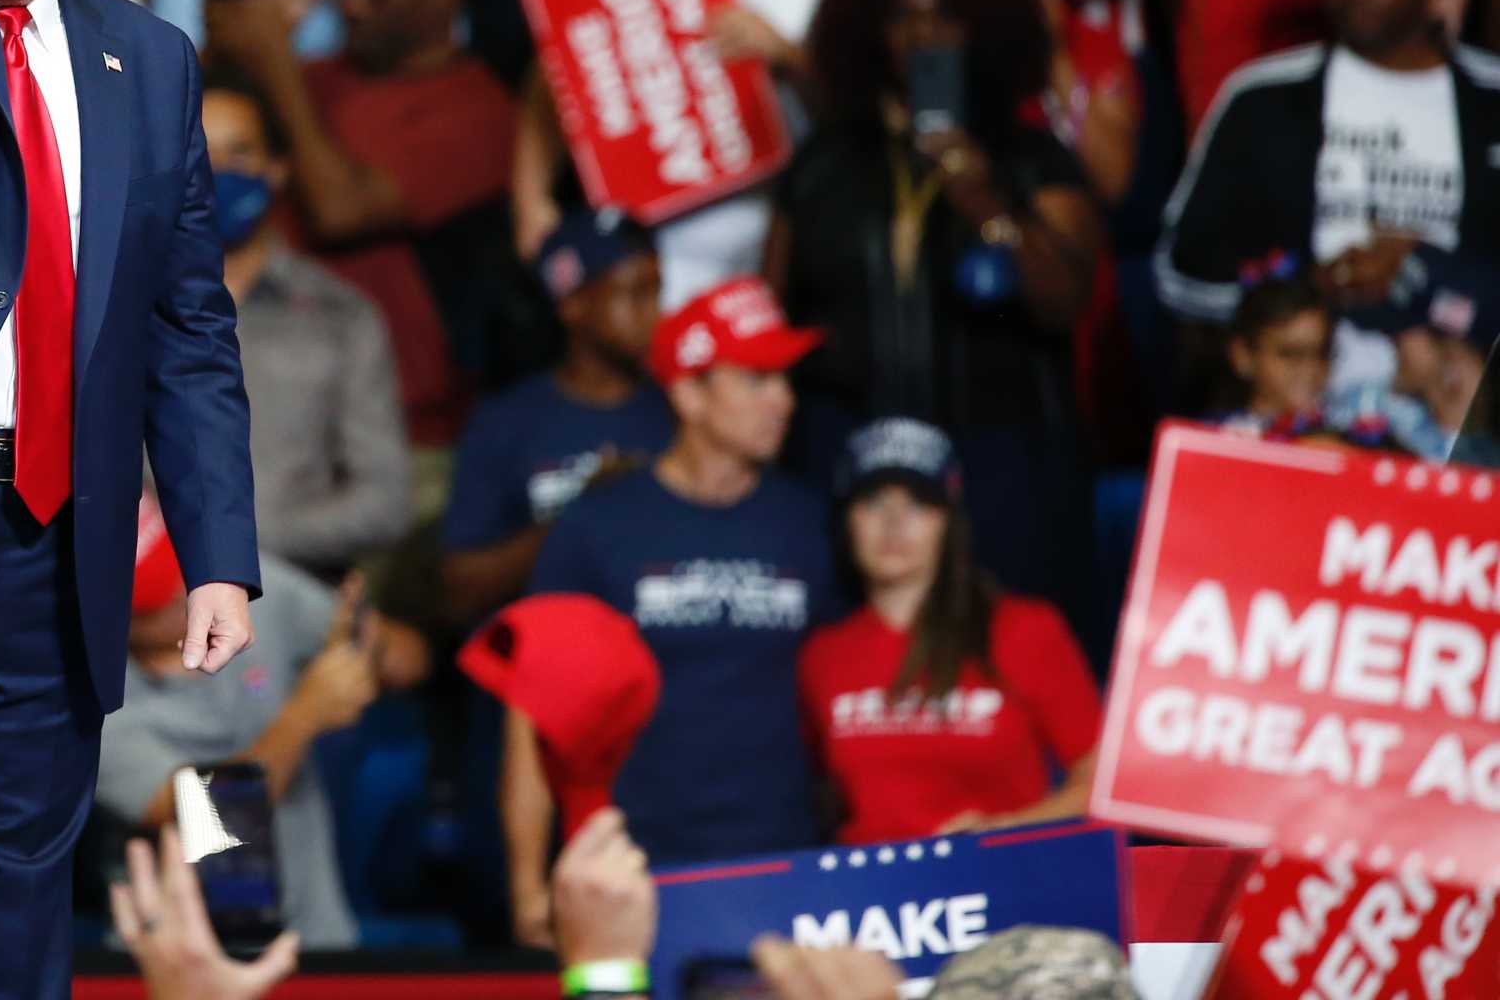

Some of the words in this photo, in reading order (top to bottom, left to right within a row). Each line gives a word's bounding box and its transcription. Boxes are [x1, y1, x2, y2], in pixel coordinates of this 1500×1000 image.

[1318, 515, 1500, 612] MAK
[1150, 577, 1500, 723] AMERI
[1136, 686, 1403, 790] GREAT
[791, 892, 990, 960] MAKE
